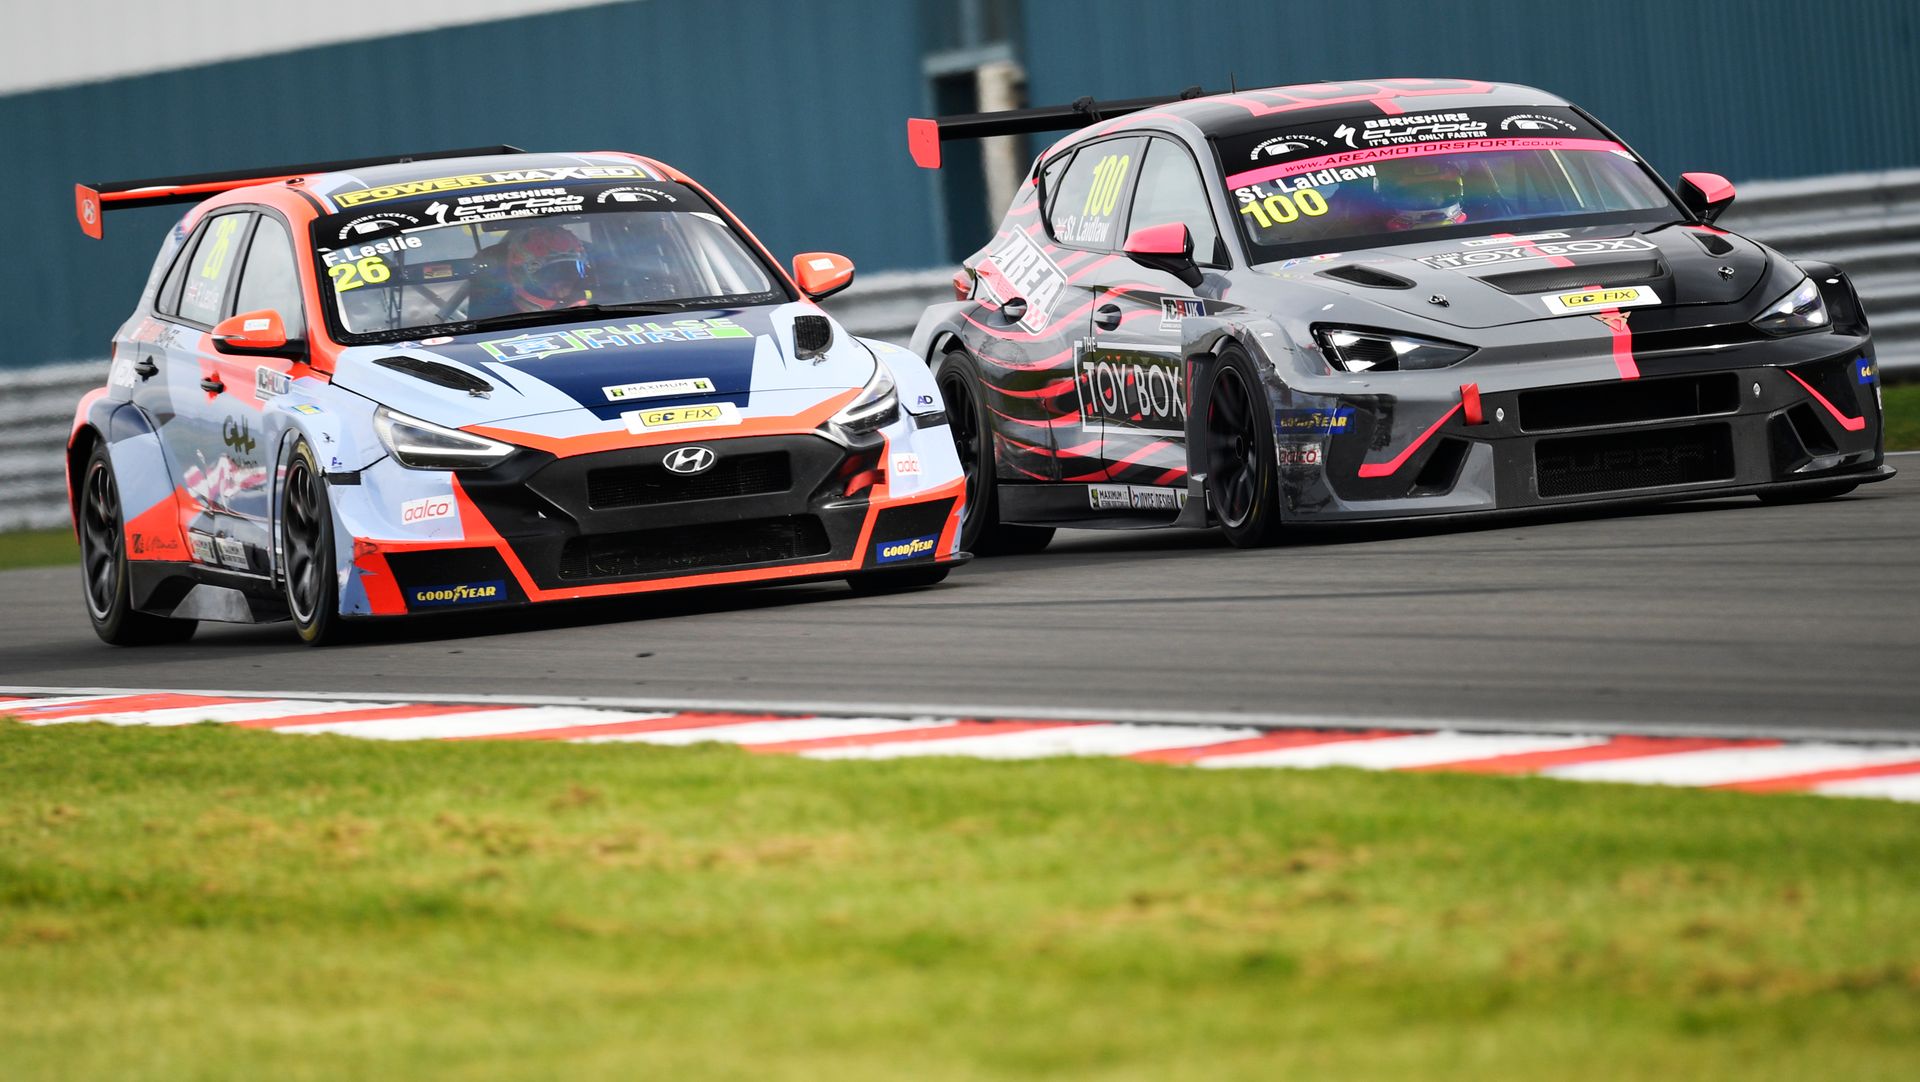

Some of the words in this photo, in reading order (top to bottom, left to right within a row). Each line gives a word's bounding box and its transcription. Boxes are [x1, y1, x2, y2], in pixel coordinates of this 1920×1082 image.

[1364, 112, 1470, 129] BERKSHIRE
[1285, 134, 1314, 143] CYCLE
[1368, 137, 1389, 147] IT'S
[1419, 133, 1445, 142] ONLY
[1446, 130, 1488, 139] FASTER
[342, 173, 489, 206] POWER
[487, 165, 637, 184] MAXED
[1083, 154, 1130, 217] 100
[1235, 185, 1273, 203] St.
[1276, 164, 1377, 194] Laidlaw
[457, 187, 568, 206] BERKSHIRE
[511, 208, 540, 217] ONLY
[541, 204, 584, 214] FASTER
[1239, 188, 1329, 229] 100
[1076, 215, 1110, 242] Laidlaw
[321, 235, 423, 268] F.Leslie
[1440, 248, 1525, 268] TOY
[1540, 238, 1632, 256] BOX
[328, 256, 391, 292] 26
[995, 231, 1062, 314] AREA
[1603, 290, 1631, 301] FIX
[1185, 302, 1198, 318] UK
[572, 317, 736, 340] PULSE
[584, 327, 712, 350] HIRE
[1083, 336, 1097, 353] THE
[627, 382, 689, 392] MAXIMUM
[1082, 361, 1129, 415] TOY
[1133, 364, 1186, 418] BOX
[684, 408, 714, 420] FIX
[404, 500, 449, 522] aalco
[883, 538, 934, 558] GOODYEAR
[416, 585, 497, 603] GOODYEAR
